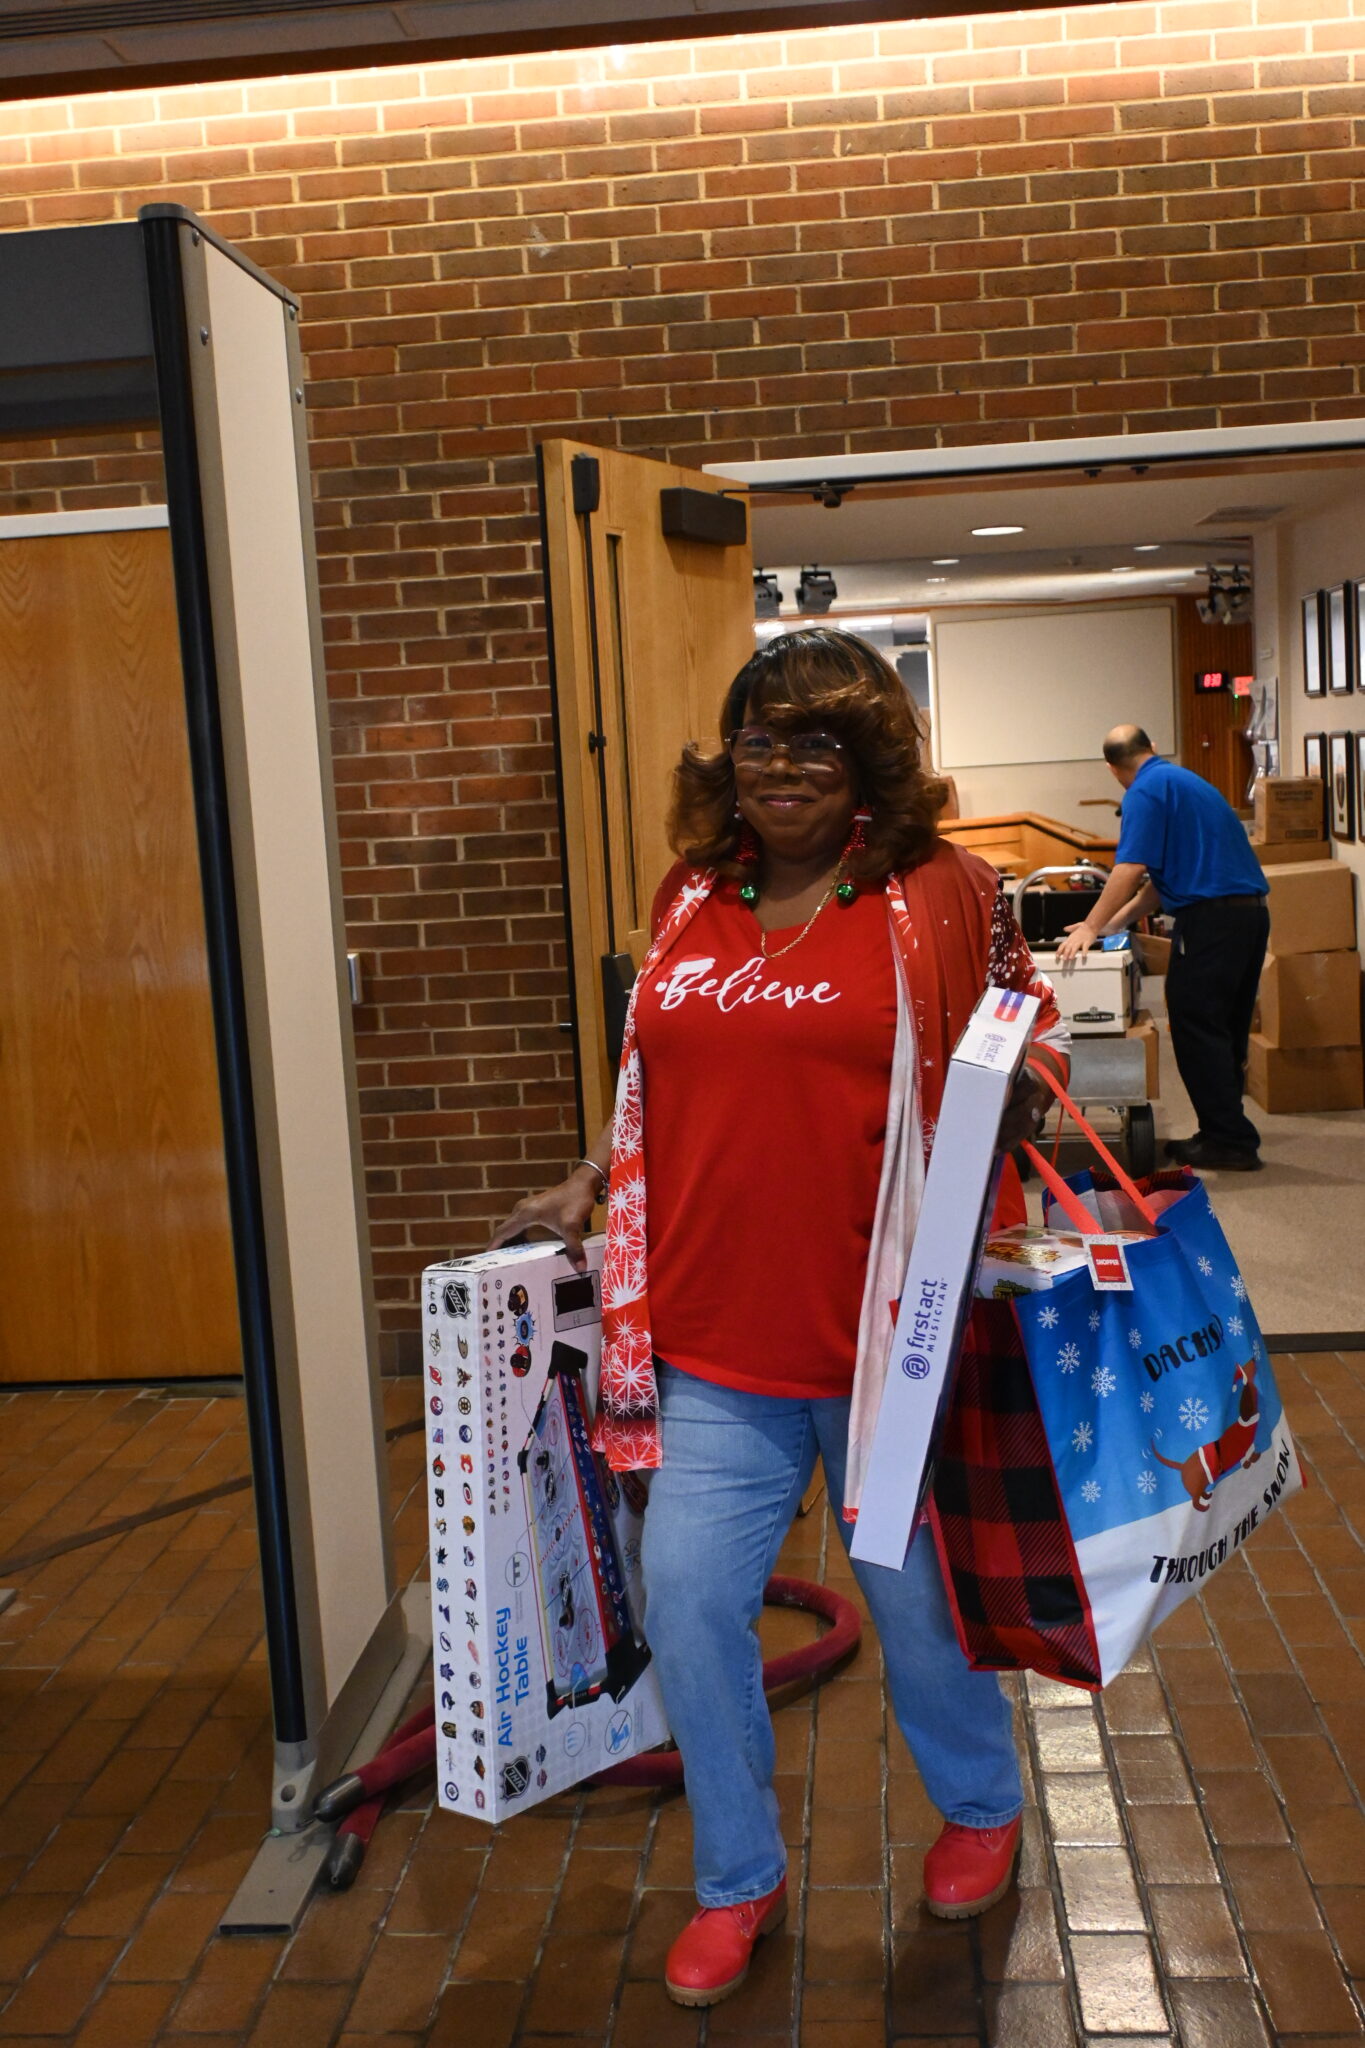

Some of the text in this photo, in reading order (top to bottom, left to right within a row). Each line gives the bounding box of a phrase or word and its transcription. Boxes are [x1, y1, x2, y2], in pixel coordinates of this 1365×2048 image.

[656, 957, 840, 1012] Believe
[1095, 1258, 1120, 1266] SHOPPER
[926, 1282, 948, 1353] MUSICIAN
[1150, 1438, 1290, 1584] THROUGH THE SNOW
[494, 1607, 513, 1746] Air Hockey
[513, 1635, 529, 1707] Table
